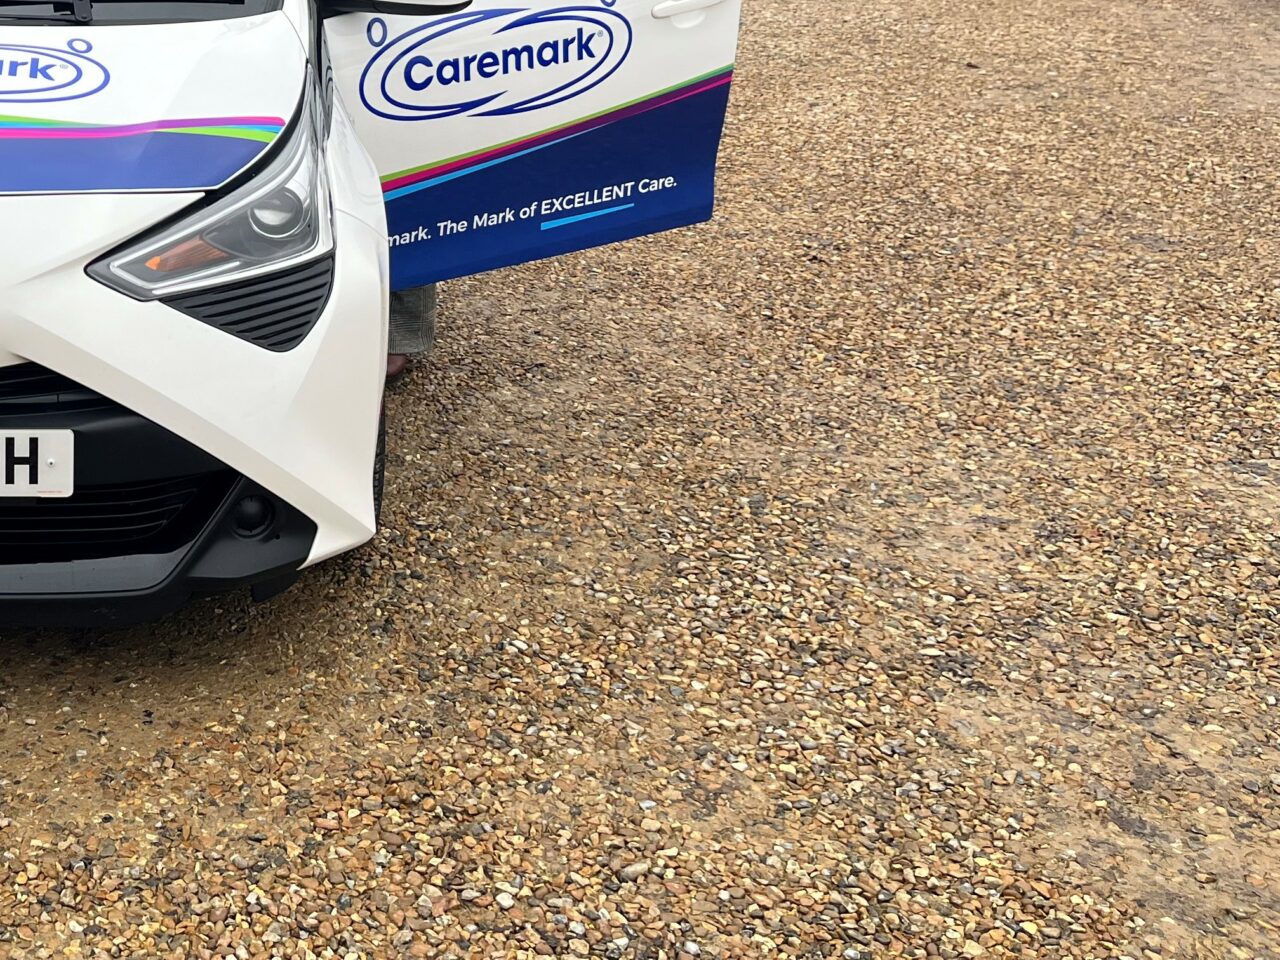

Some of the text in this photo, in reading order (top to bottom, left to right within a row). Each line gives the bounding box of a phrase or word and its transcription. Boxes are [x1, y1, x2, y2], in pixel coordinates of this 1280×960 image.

[404, 27, 597, 91] Caremark
[437, 220, 468, 236] The
[473, 208, 515, 229] Mark
[520, 202, 539, 219] of
[540, 181, 635, 215] EXCELLENT
[638, 174, 678, 195] Care.
